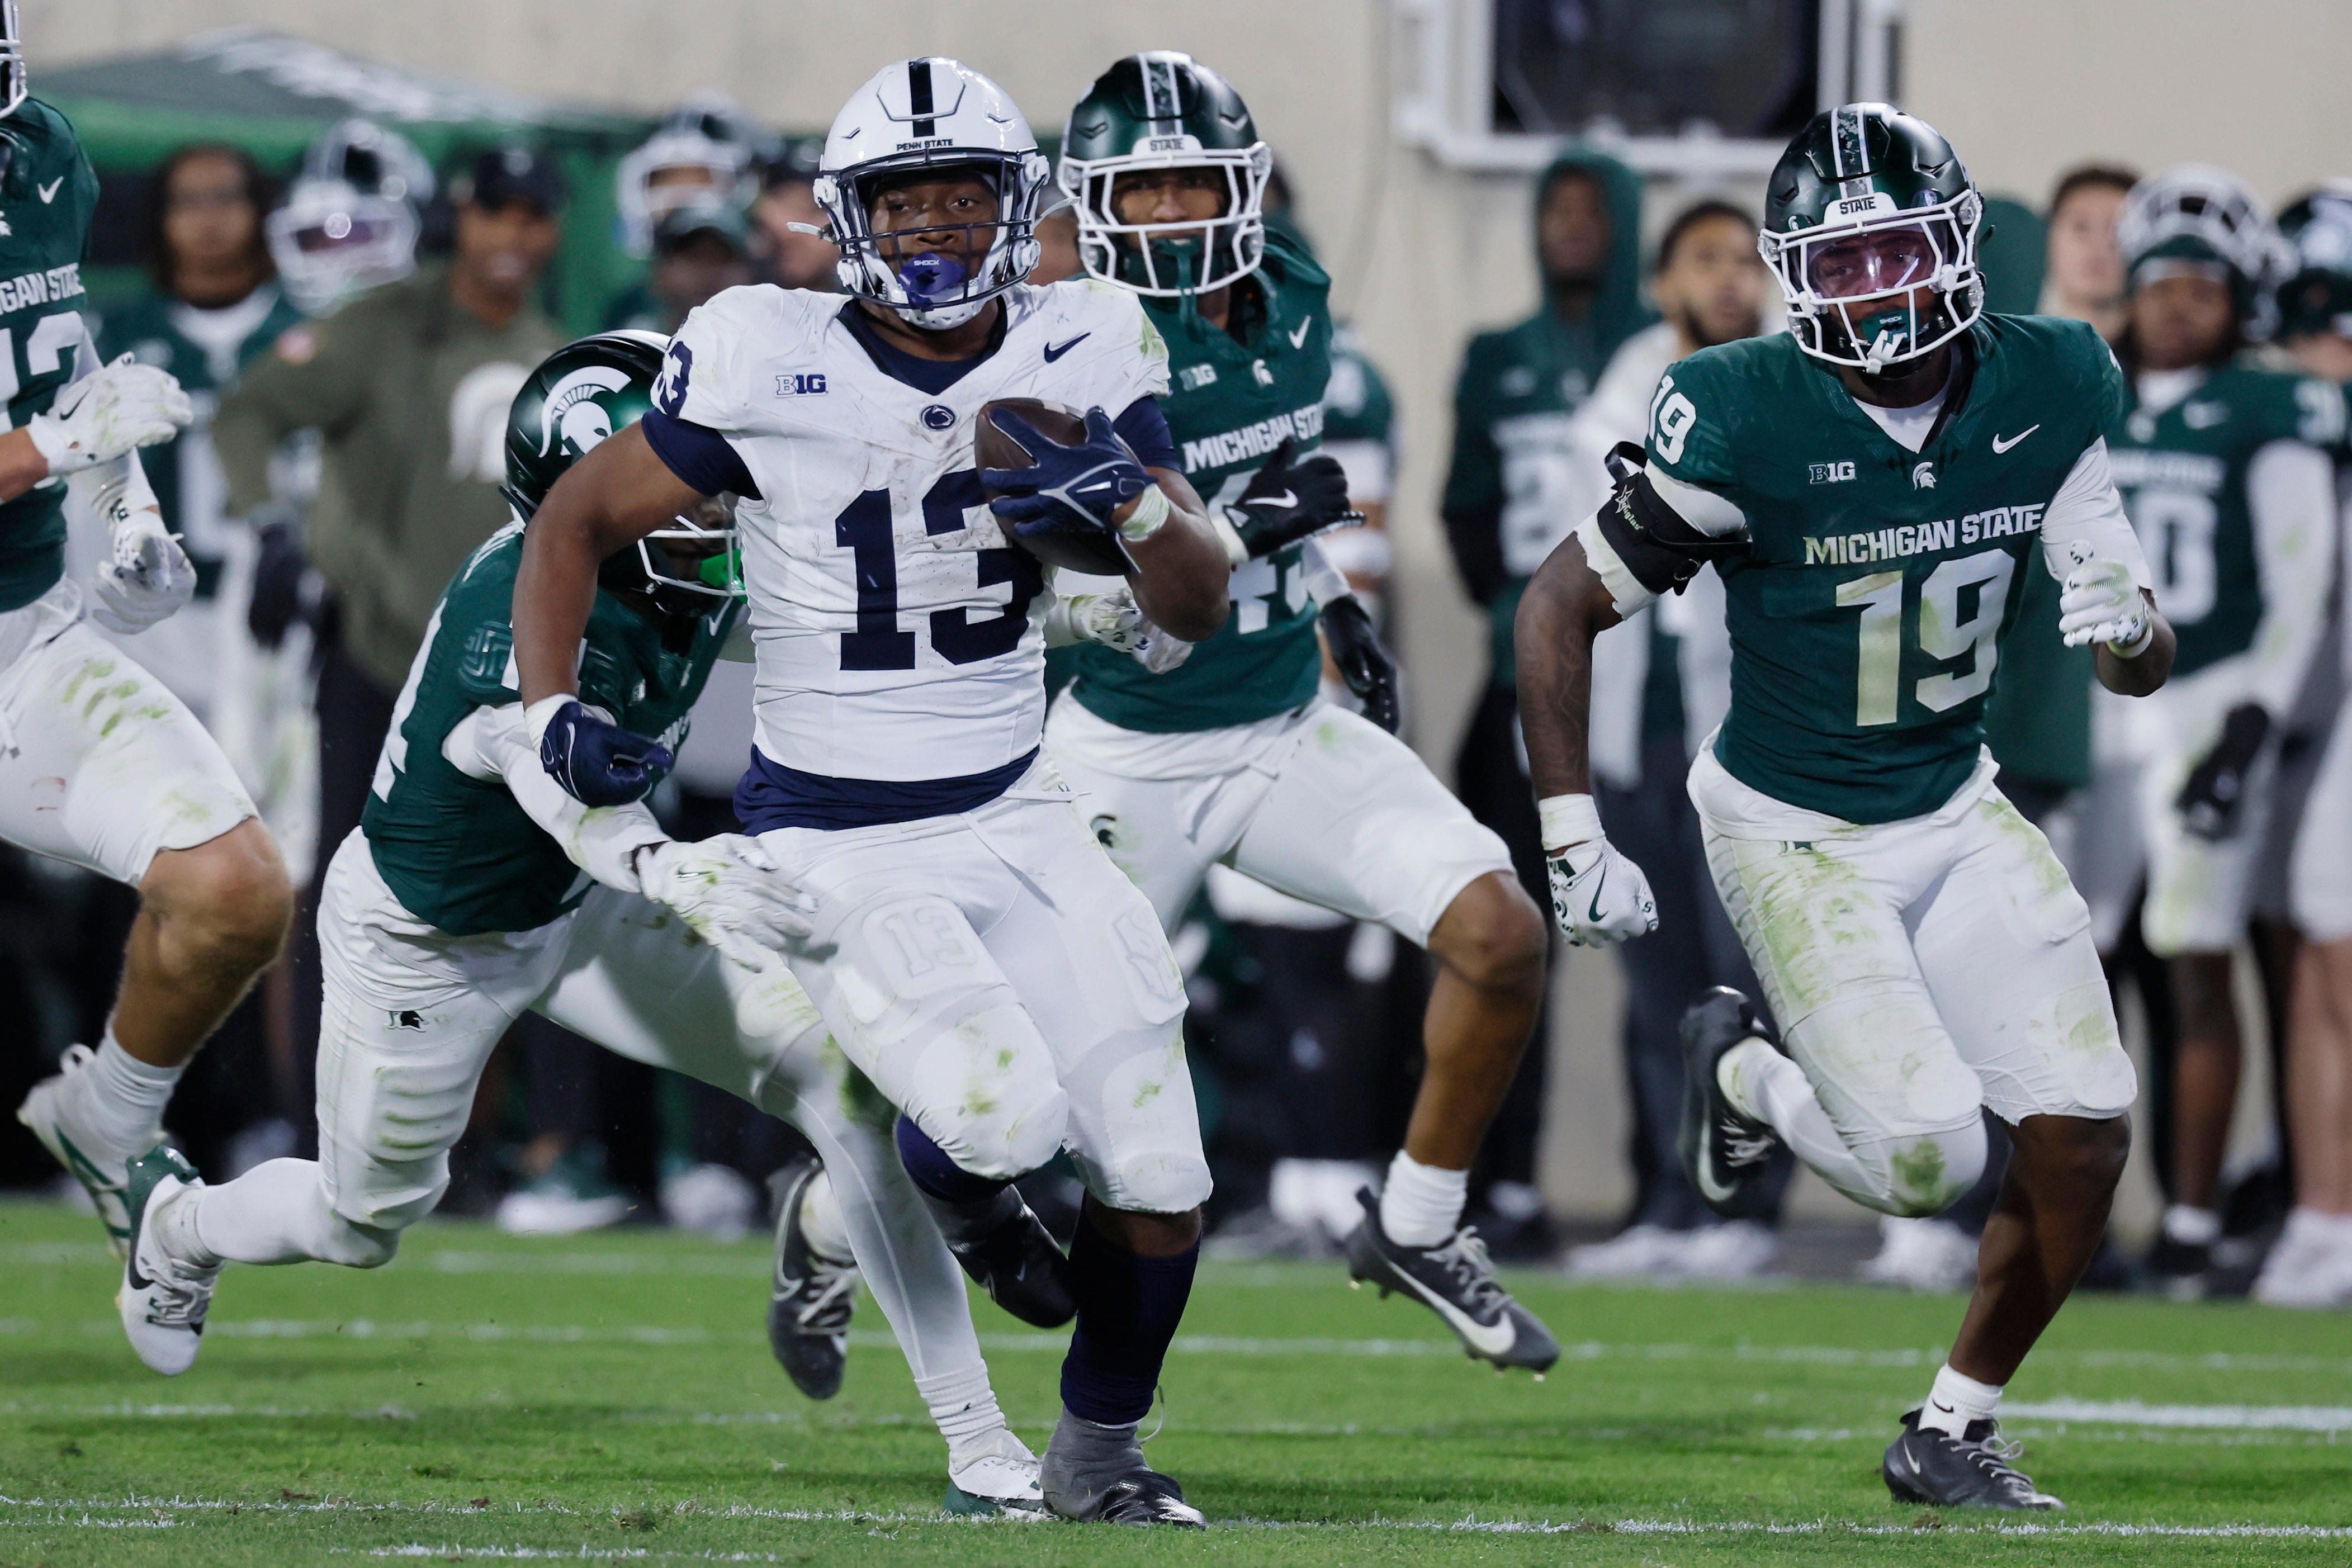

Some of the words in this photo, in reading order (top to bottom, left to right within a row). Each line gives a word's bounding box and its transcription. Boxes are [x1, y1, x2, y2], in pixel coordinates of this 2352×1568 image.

[897, 141, 922, 151] PENN
[925, 139, 953, 148] STATE
[1150, 138, 1184, 151] STATE
[1839, 196, 1877, 215] STATE
[1182, 413, 1295, 475] MICHIGAN
[1649, 375, 1696, 465] 19
[1802, 519, 1956, 565] MICHIGAN
[1961, 502, 2046, 544] STATE
[835, 467, 1044, 670] 13
[1836, 548, 2015, 727] 19
